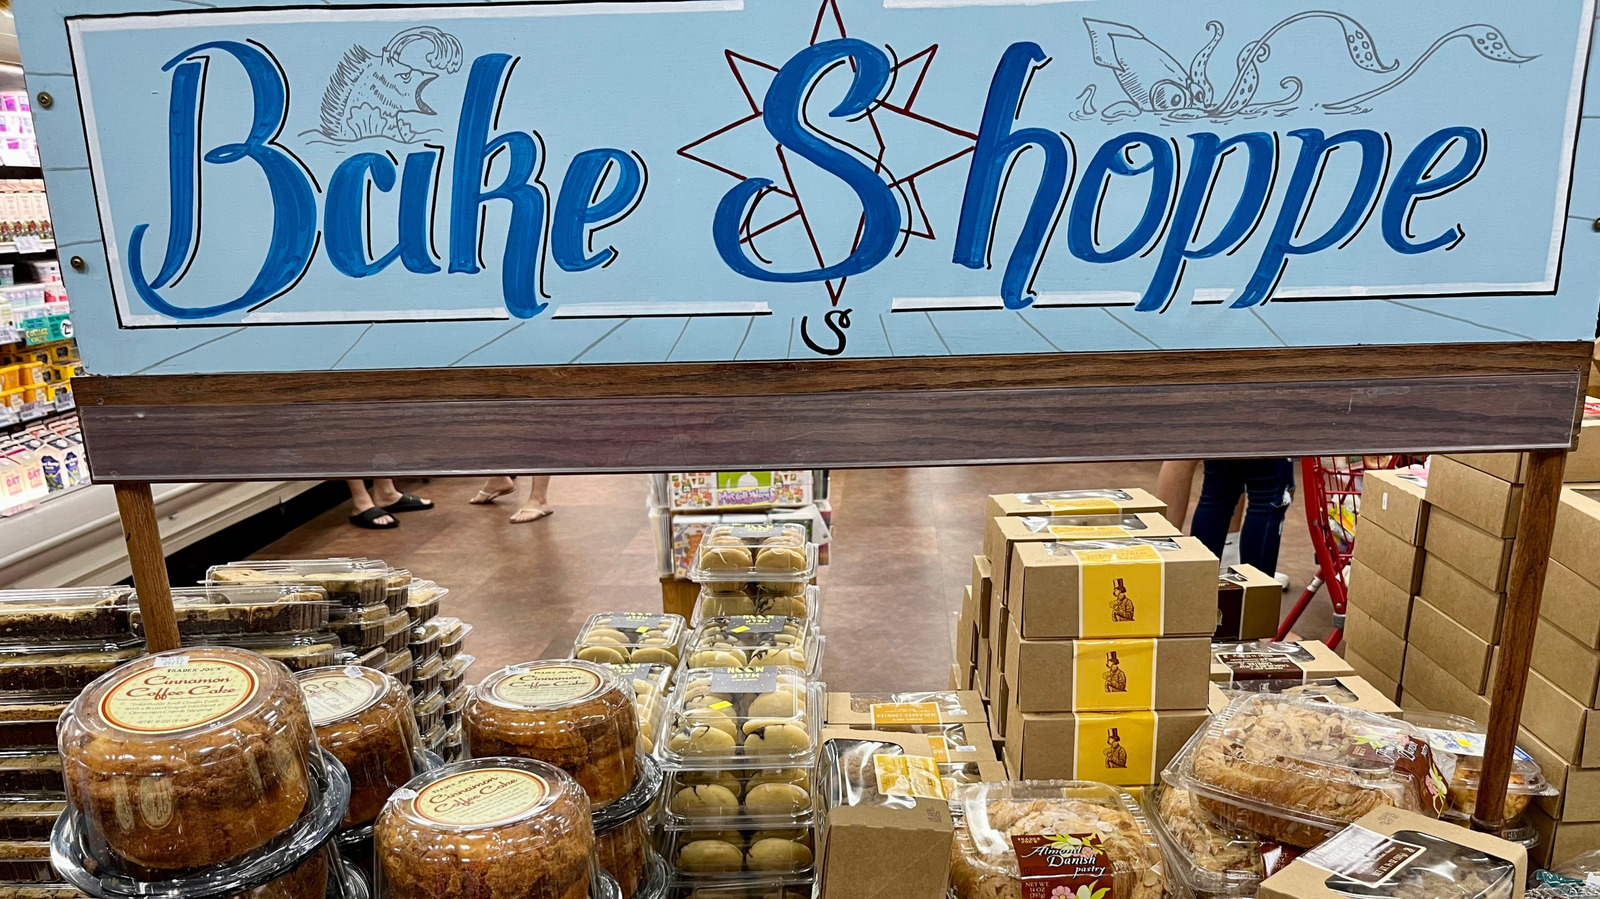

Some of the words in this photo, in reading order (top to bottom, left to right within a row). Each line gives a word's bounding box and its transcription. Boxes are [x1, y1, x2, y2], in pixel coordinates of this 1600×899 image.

[128, 39, 648, 319] Bake
[713, 38, 1487, 311] Shoppe
[801, 308, 853, 356] S
[144, 675, 230, 685] Cinnamon
[509, 681, 550, 689] Coffee
[126, 687, 185, 700] Coffee
[188, 685, 236, 695] Cake
[429, 777, 498, 804] Cinnamon
[434, 795, 481, 812] Coffee
[480, 779, 517, 795] Cake
[1021, 846, 1082, 858] Almond
[1046, 854, 1096, 867] Danish
[1073, 866, 1106, 879] pastry
